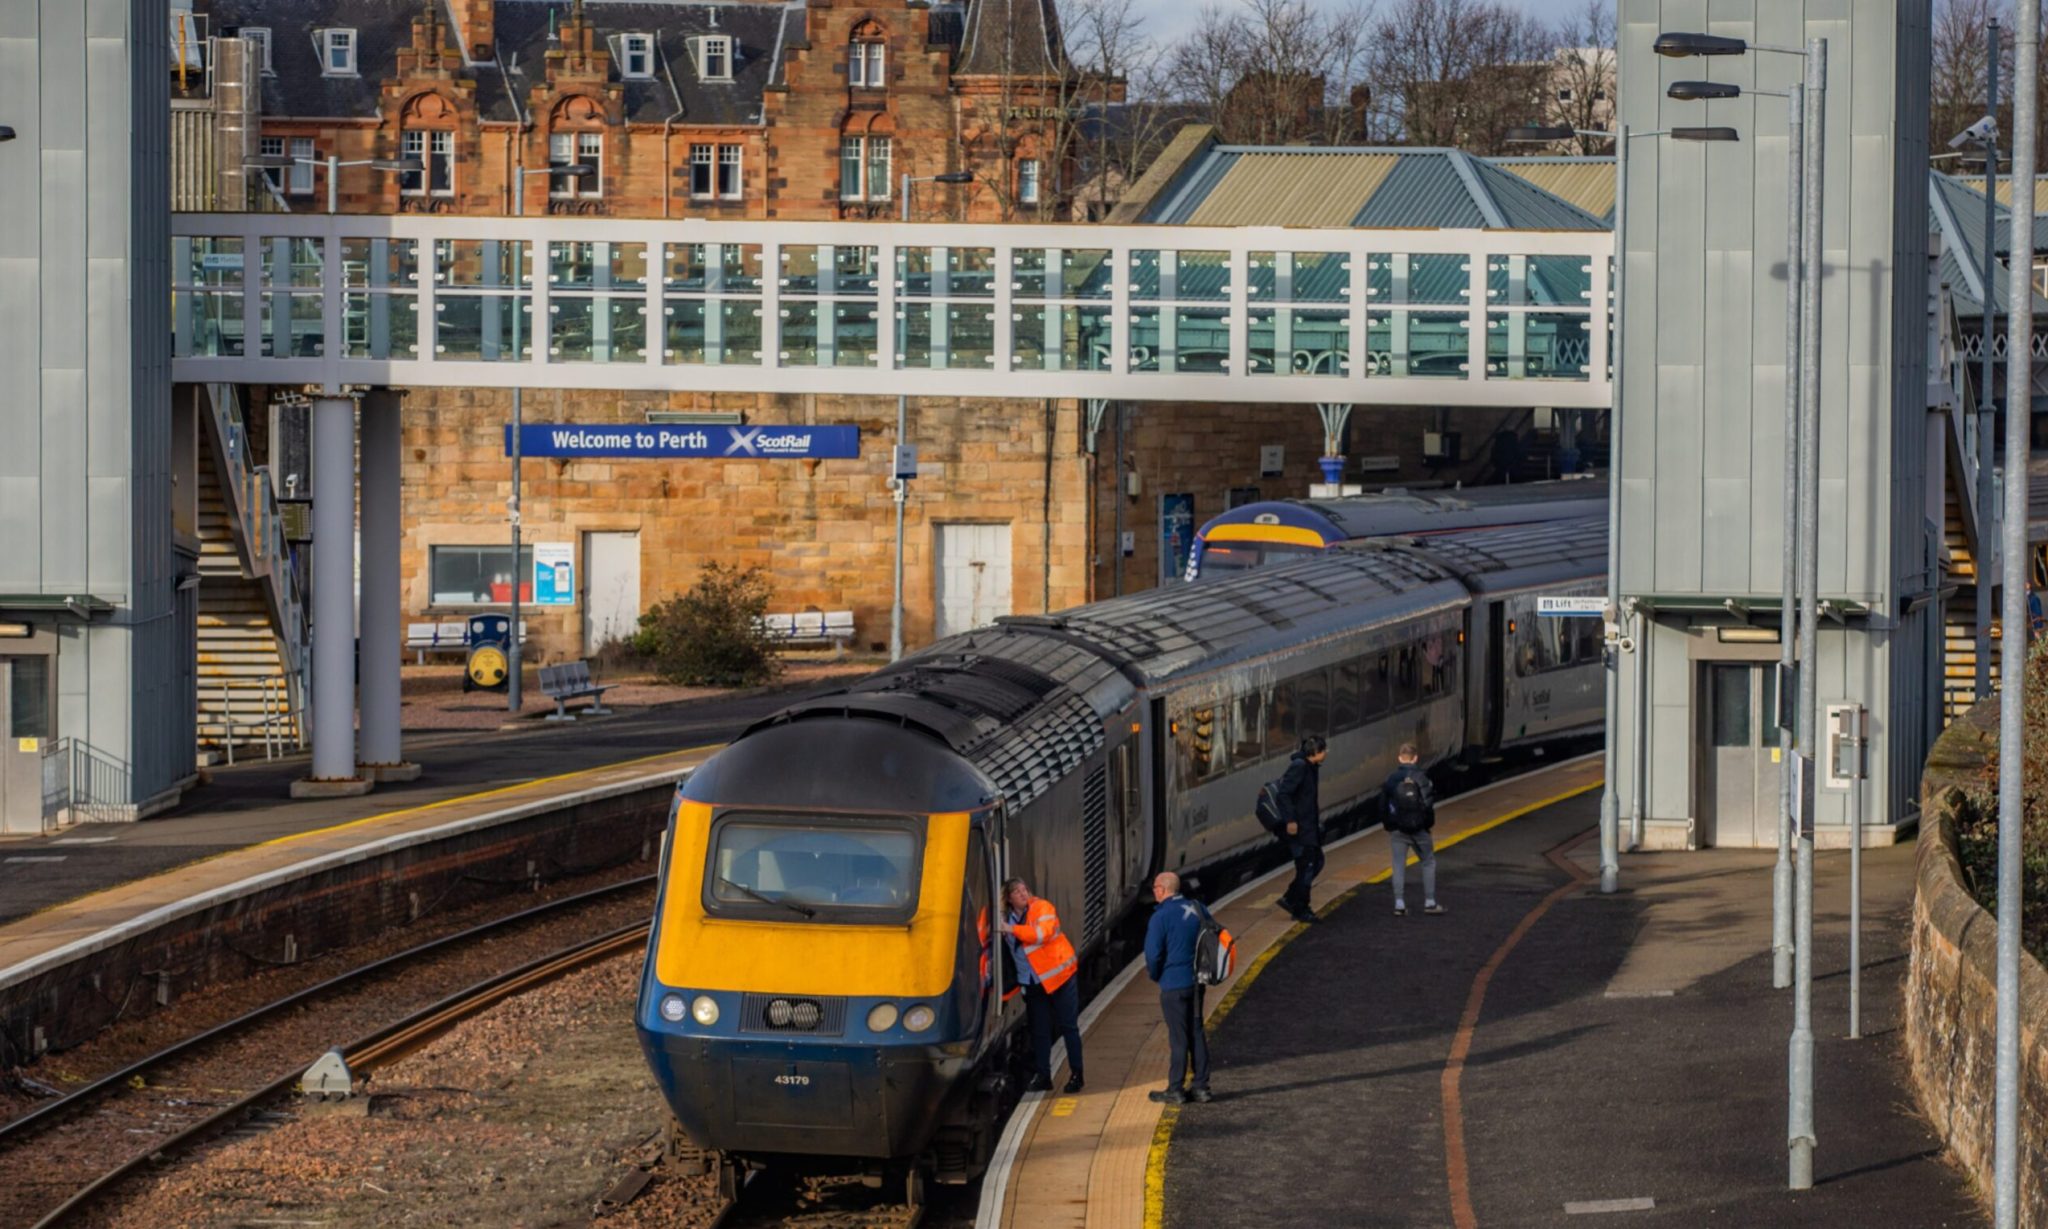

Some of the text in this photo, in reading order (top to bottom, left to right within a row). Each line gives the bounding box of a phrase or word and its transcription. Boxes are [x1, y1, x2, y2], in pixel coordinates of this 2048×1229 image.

[552, 430, 707, 449] Welcome to Perth
[756, 434, 812, 448] ScotRail
[1555, 599, 1571, 609] Lift
